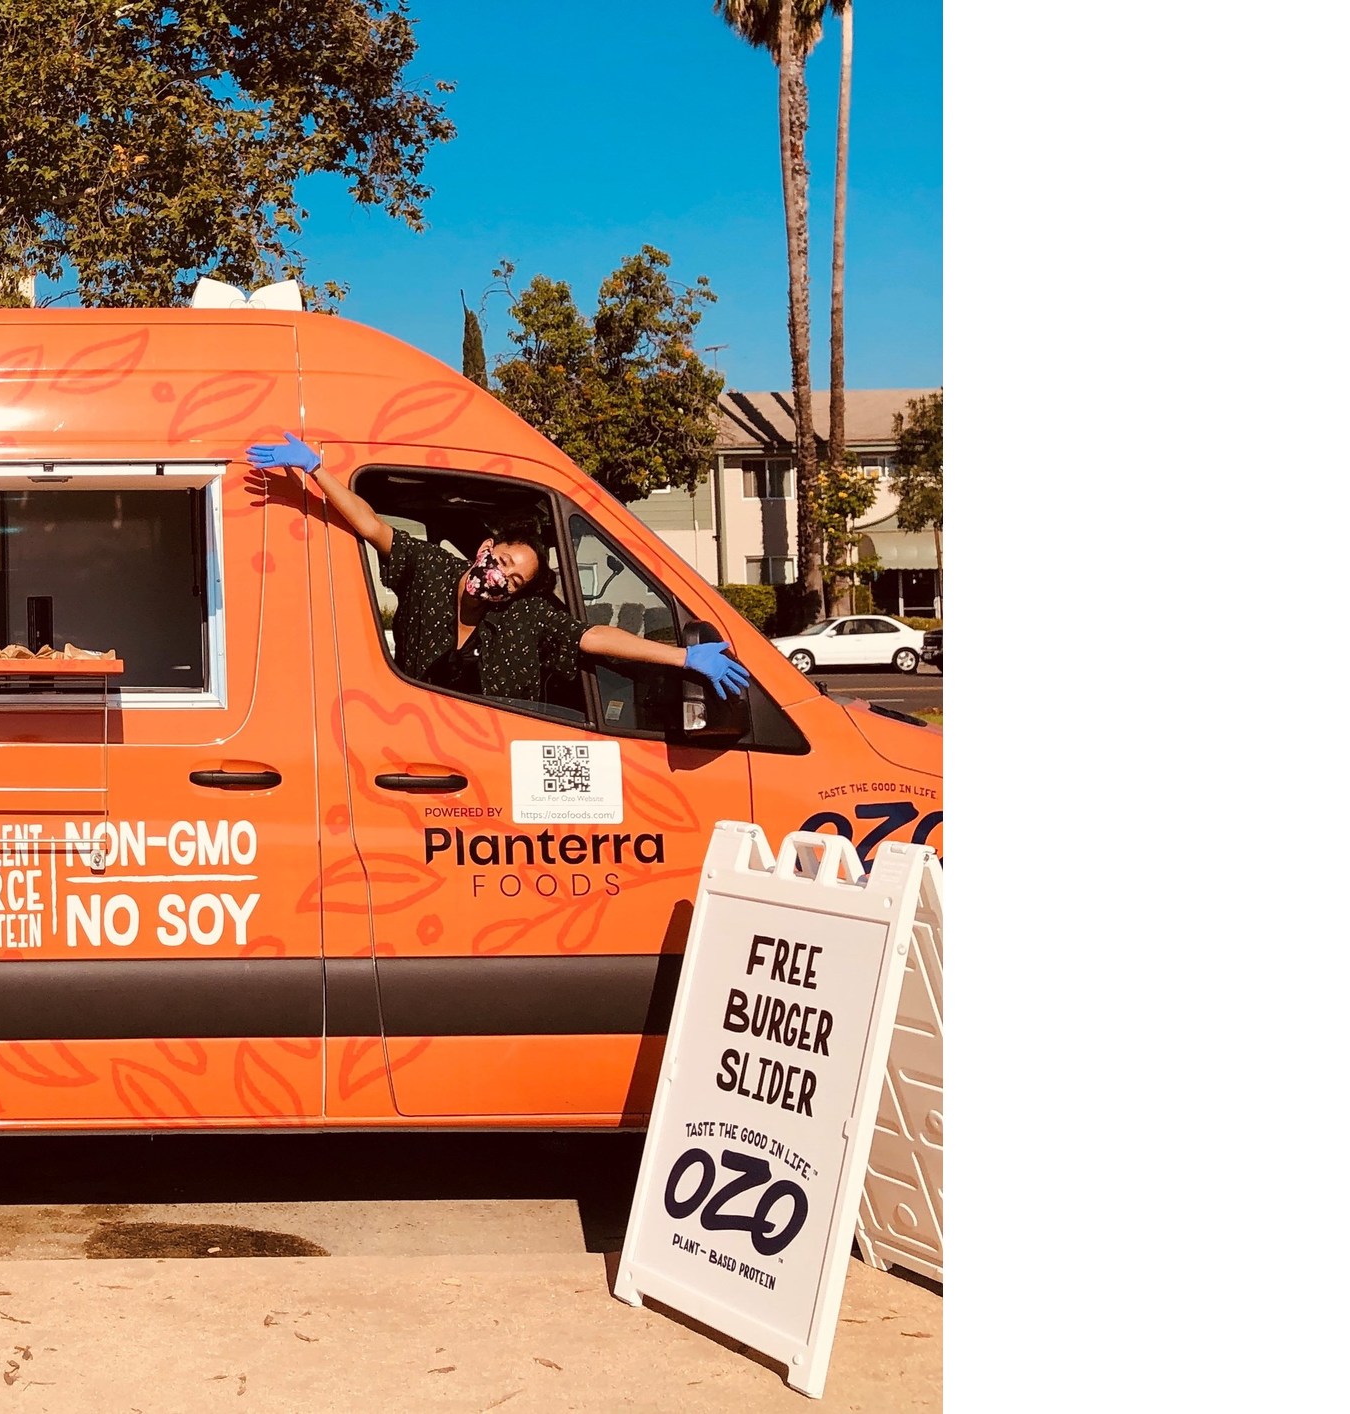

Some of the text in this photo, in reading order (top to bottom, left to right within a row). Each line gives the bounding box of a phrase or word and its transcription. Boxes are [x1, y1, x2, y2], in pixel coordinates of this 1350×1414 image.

[530, 794, 546, 802] Scan
[548, 794, 559, 802] For
[818, 783, 936, 800] TASTE THE GOOD IN LIFE
[425, 807, 502, 818] POWERED BY
[520, 811, 616, 820] https://ozofoods.com/
[65, 820, 258, 867] NON-GMO
[424, 826, 665, 865] Planterra
[473, 872, 620, 898] FOODS
[66, 893, 261, 947] NO SOY
[746, 934, 823, 990] FREE
[723, 988, 833, 1057] BURGER
[716, 1048, 817, 1118] SLIDER
[686, 1122, 715, 1138] TASTE
[719, 1122, 738, 1140] THE
[740, 1128, 768, 1149] GOOD
[769, 1139, 784, 1159] IN
[664, 1148, 809, 1256] OZO
[739, 1262, 776, 1291] PROTEIN
